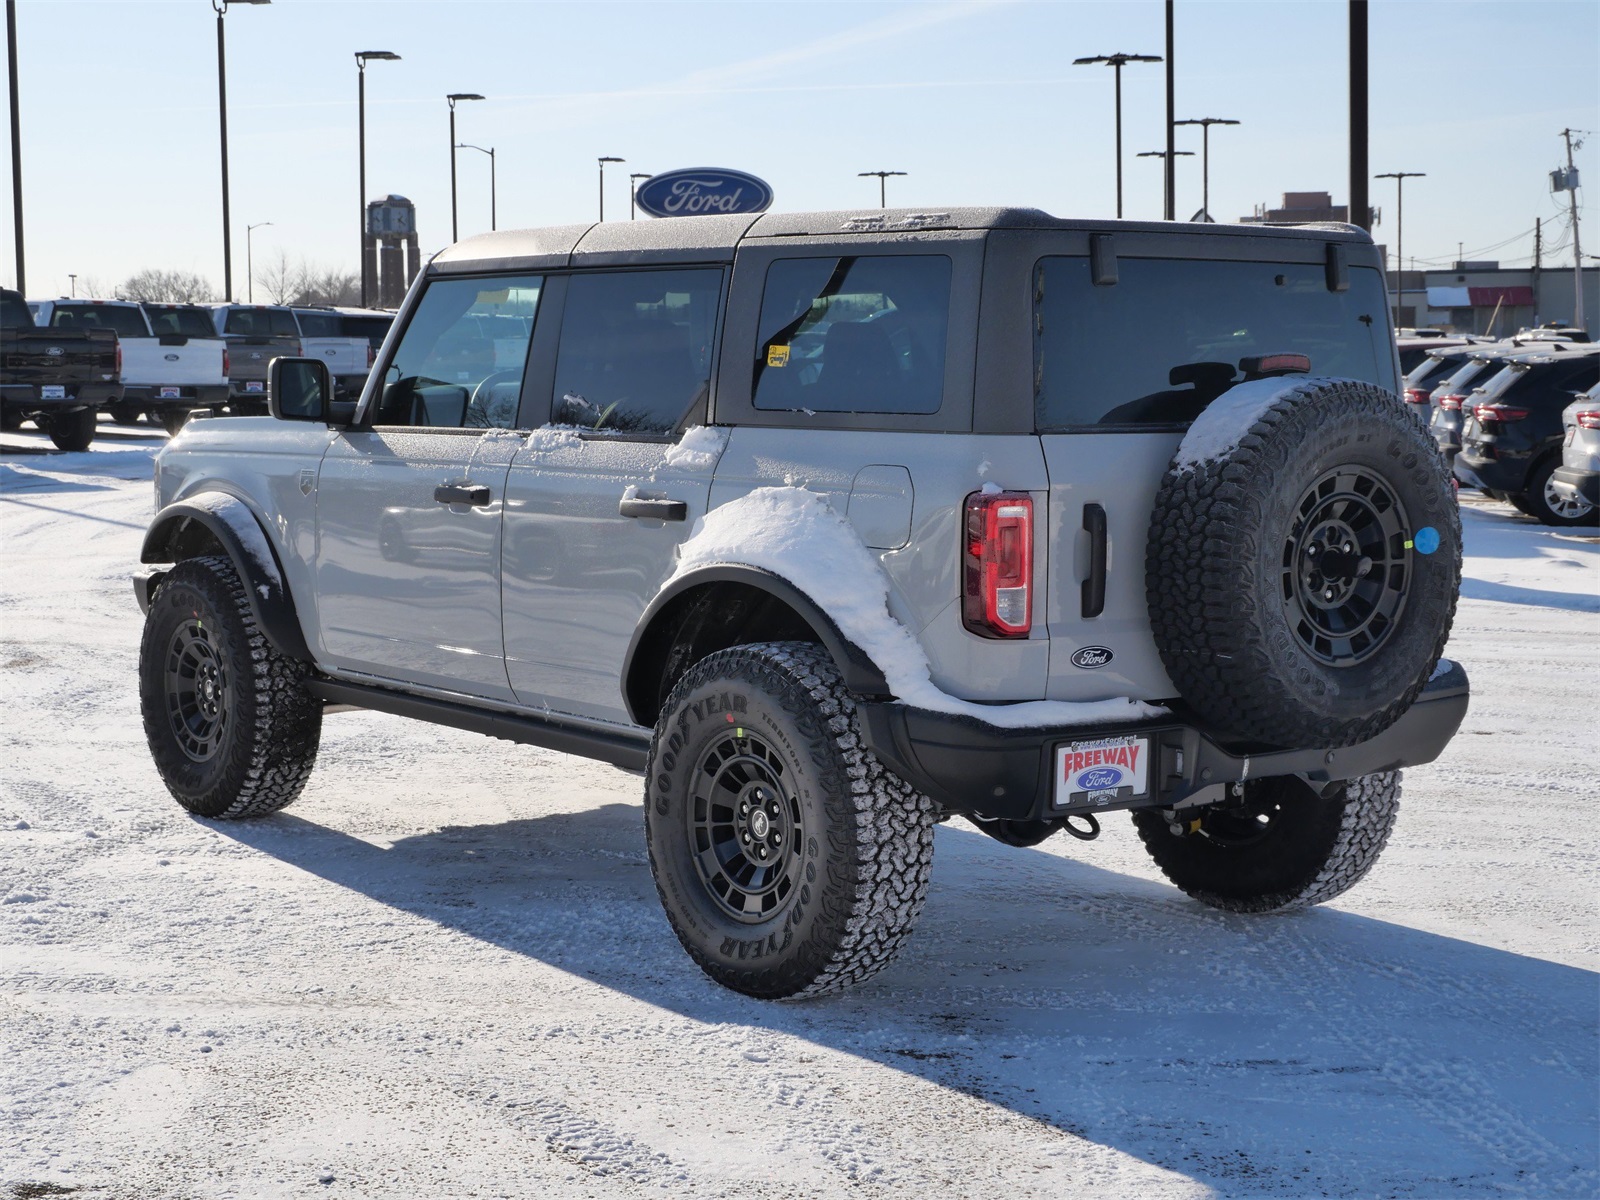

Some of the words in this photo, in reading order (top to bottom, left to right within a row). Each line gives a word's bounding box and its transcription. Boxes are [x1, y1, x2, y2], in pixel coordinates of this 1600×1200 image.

[664, 179, 743, 212] Ford
[1081, 650, 1107, 665] Ford
[762, 712, 804, 776] TERRITORY
[1064, 745, 1140, 786] FREEWAY
[1085, 770, 1114, 787] Ford
[1087, 787, 1119, 803] FREEWAY
